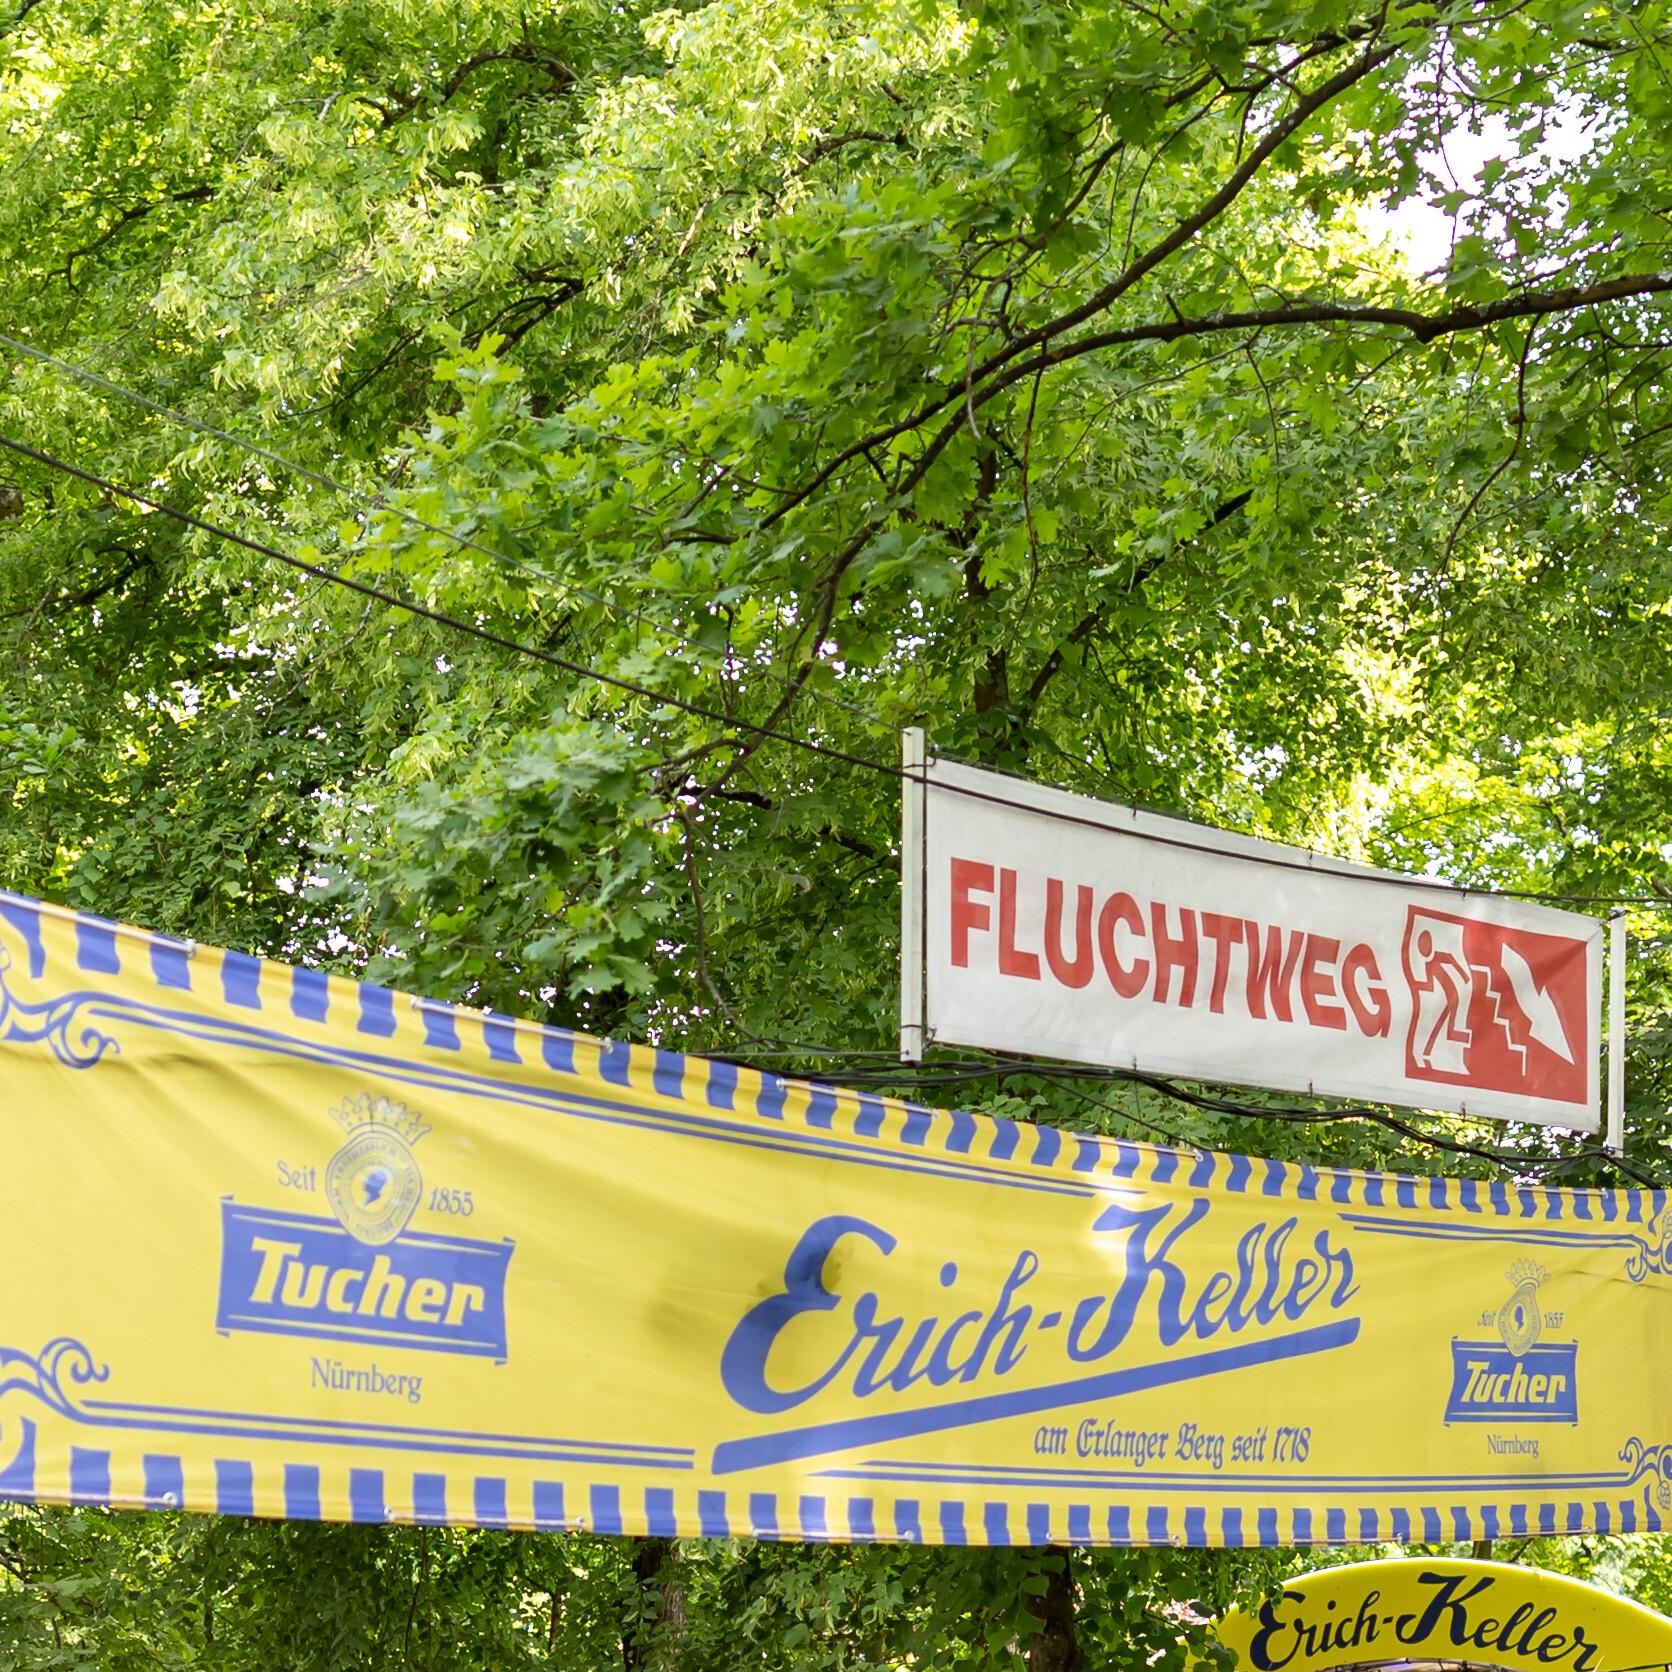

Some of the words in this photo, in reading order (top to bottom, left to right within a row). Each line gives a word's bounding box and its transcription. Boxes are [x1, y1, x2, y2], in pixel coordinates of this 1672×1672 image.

[949, 856, 1392, 1039] FLUCHTWEG
[276, 1161, 317, 1192] Seit
[428, 1187, 474, 1217] 1855
[248, 1236, 485, 1326] Tucher
[719, 1197, 1361, 1415] Erich-Keller
[311, 1356, 423, 1404] Nürnberg
[1460, 1360, 1567, 1404] Tucher
[1033, 1424, 1067, 1456] am
[1075, 1418, 1169, 1469] Erlanger
[1173, 1422, 1224, 1469] Berg
[1231, 1424, 1266, 1464] seit
[1273, 1426, 1312, 1463] 1718
[1487, 1434, 1540, 1459] Nürnberg
[1249, 1571, 1600, 1672] Erich-Keller
